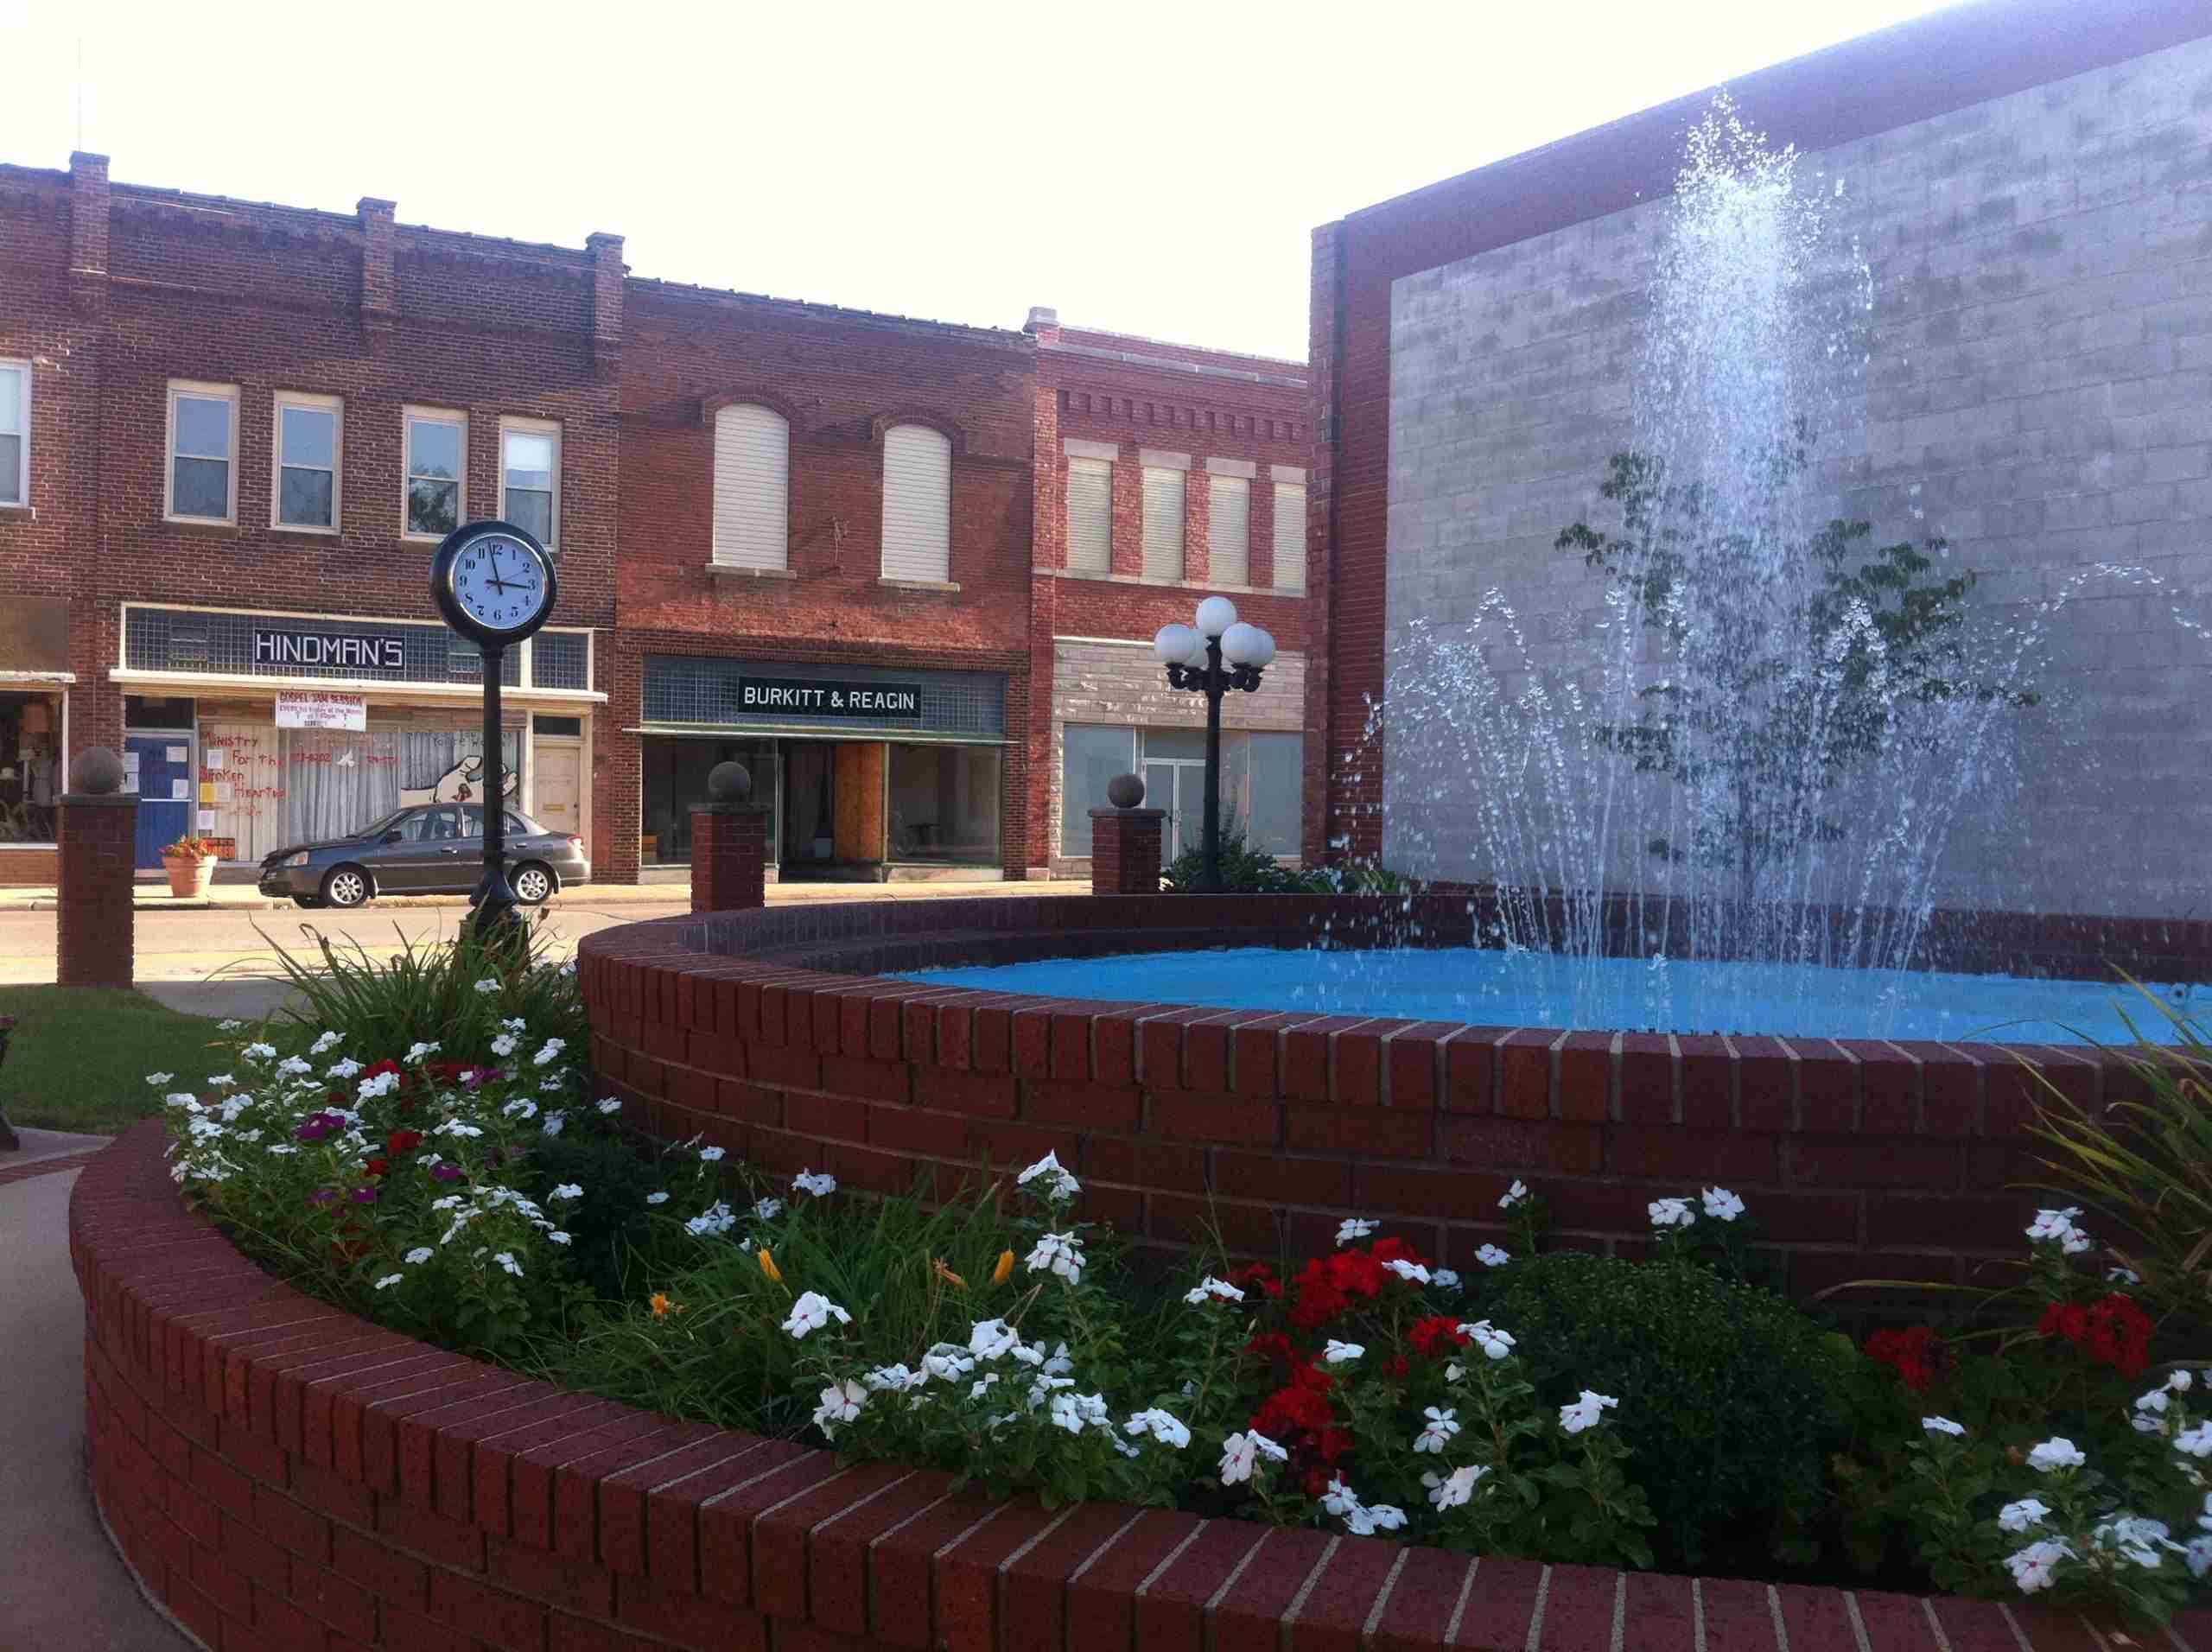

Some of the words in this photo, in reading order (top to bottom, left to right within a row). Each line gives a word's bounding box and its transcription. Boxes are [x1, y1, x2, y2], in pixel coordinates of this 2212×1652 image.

[478, 548, 485, 559] 11
[492, 544, 504, 556] 12
[512, 549, 517, 561] 1
[465, 559, 476, 570] 10
[522, 562, 531, 573] 2
[459, 575, 467, 588] 9
[527, 579, 537, 591] 3
[465, 593, 474, 603] 8
[476, 605, 485, 616] 7
[493, 609, 502, 620] 6
[511, 606, 519, 617] 5
[256, 633, 403, 666] HINDMAN'S
[744, 686, 825, 707] BURKITT
[830, 690, 844, 708] &
[849, 691, 915, 709] REAGIN
